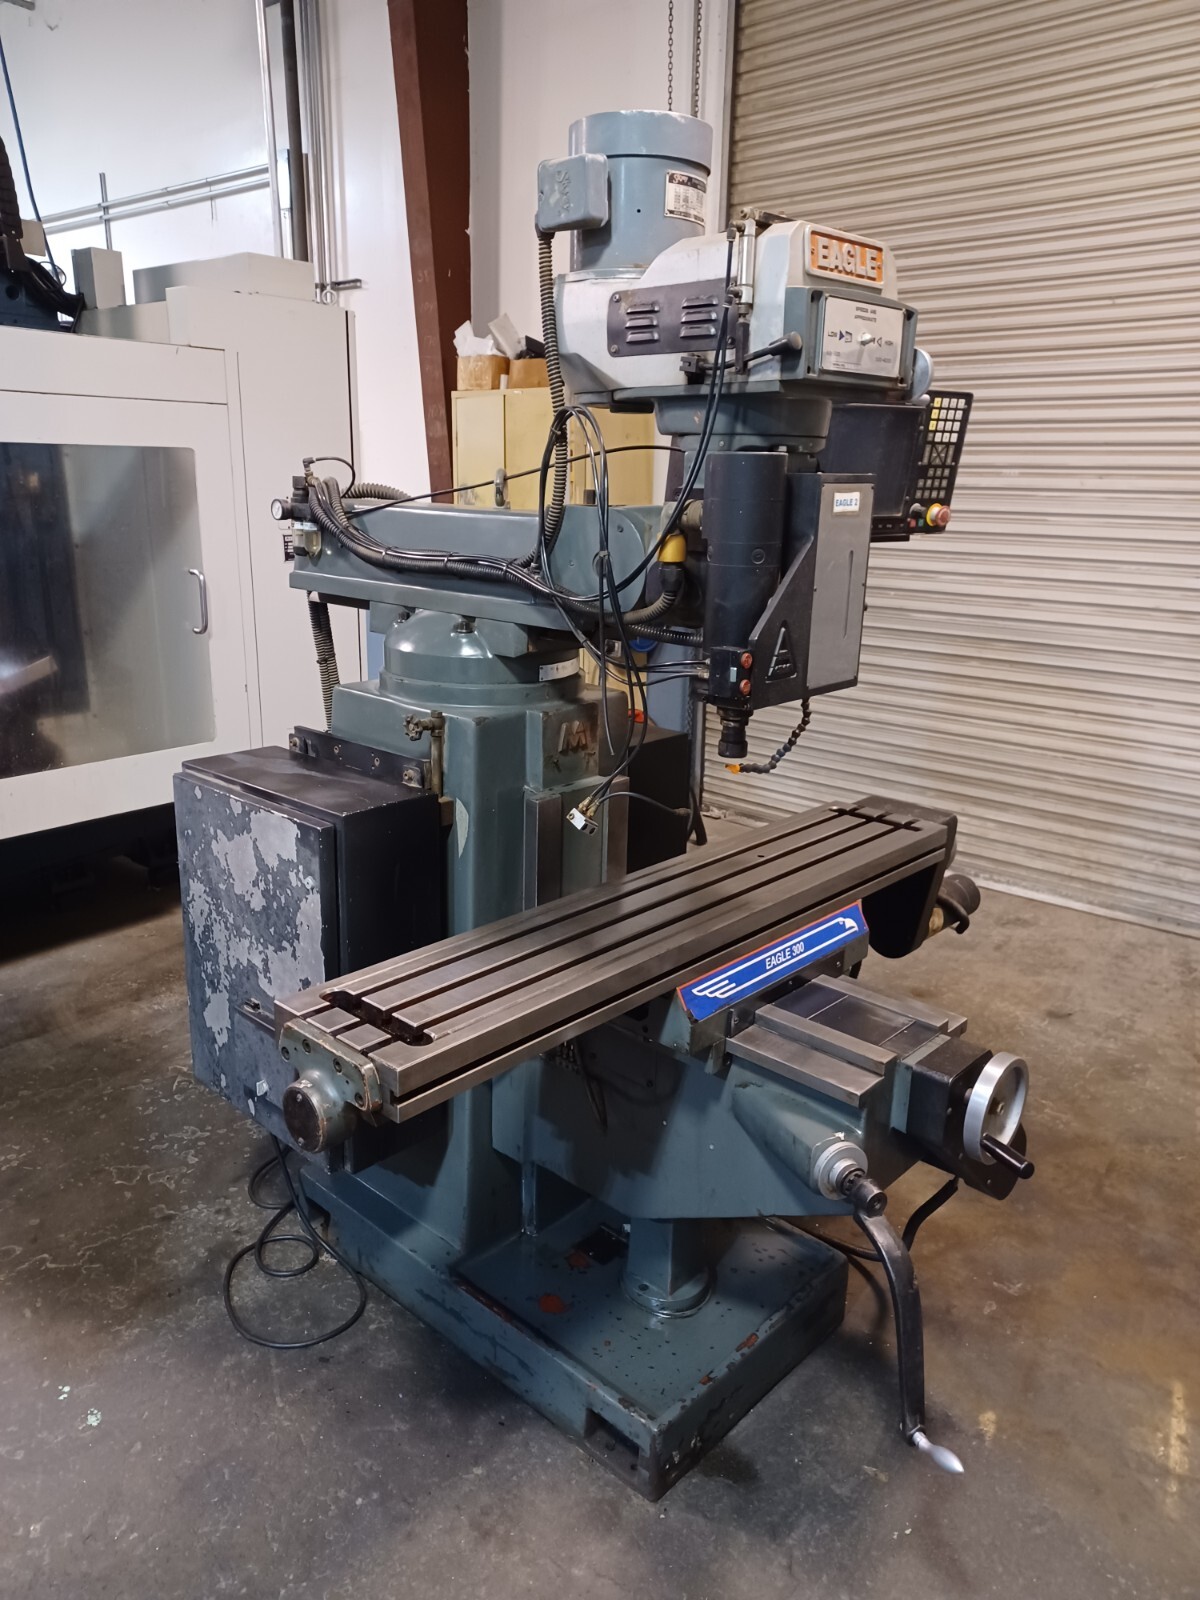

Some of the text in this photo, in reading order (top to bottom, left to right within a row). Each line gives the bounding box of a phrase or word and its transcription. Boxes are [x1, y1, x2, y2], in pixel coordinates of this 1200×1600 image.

[816, 236, 878, 281] EAGLE
[835, 498, 853, 507] EAGLE
[765, 941, 805, 970] EAGLE 300
